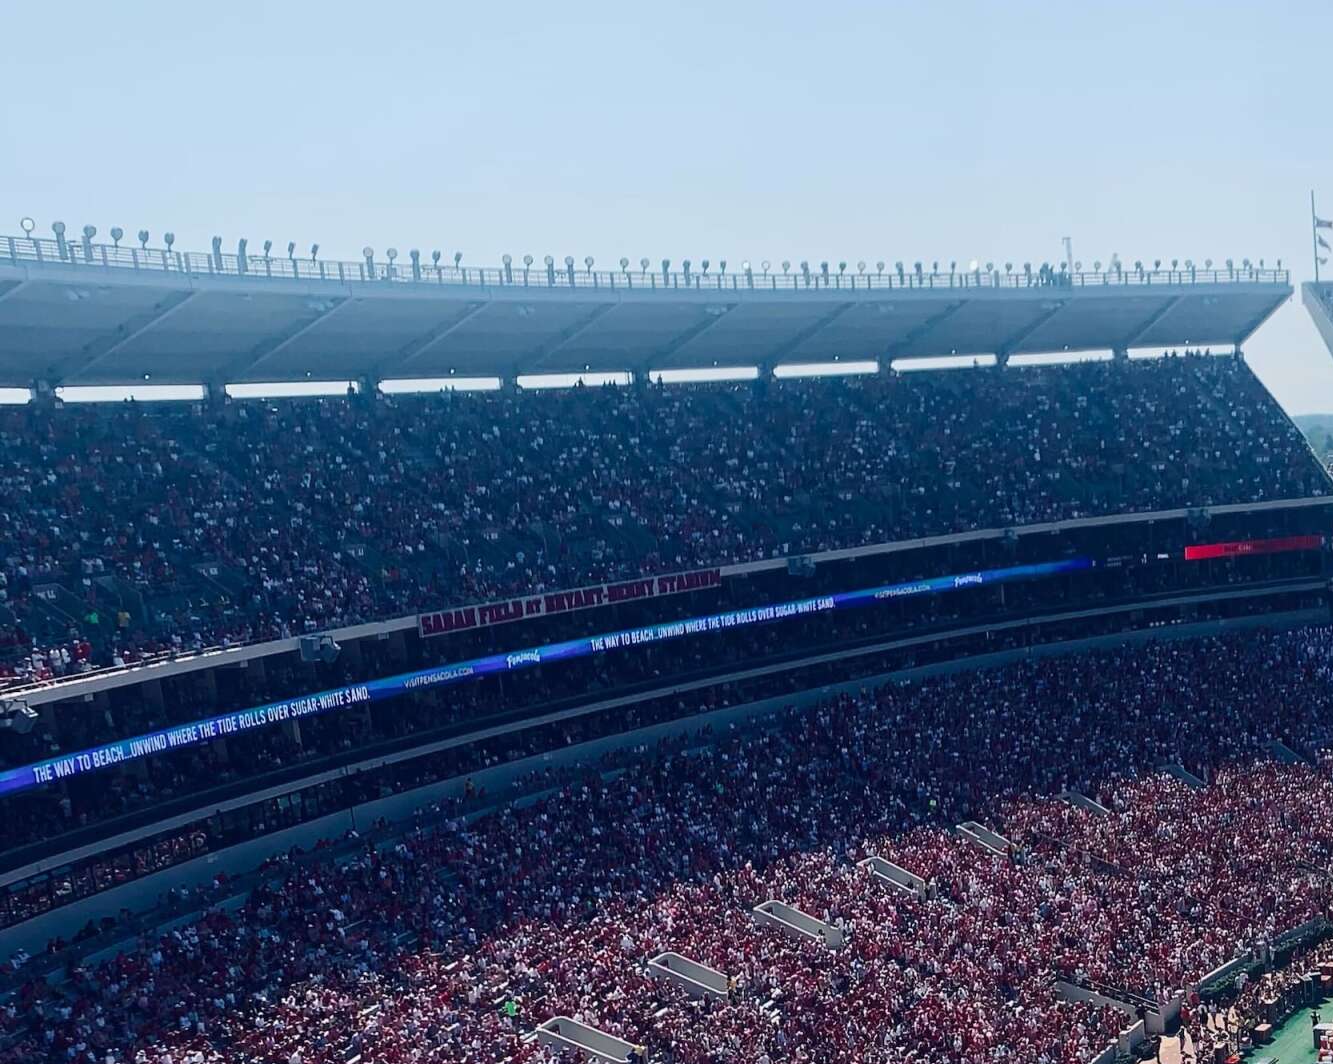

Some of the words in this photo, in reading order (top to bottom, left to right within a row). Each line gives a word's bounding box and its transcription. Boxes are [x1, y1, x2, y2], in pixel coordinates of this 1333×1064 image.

[591, 638, 603, 651] THE
[604, 636, 619, 648] WAY
[620, 633, 630, 645] TO
[685, 618, 706, 633] WHERE
[707, 615, 720, 630] THE
[720, 612, 736, 627] TIDE
[737, 610, 757, 624] ROLLS
[758, 606, 775, 620] OVER
[776, 600, 816, 618] SUGAR-WHITE
[33, 766, 53, 784] THE
[53, 762, 77, 780] WAY
[77, 757, 91, 772] TO
[167, 726, 198, 748] WHERE
[199, 721, 217, 739] THE
[217, 716, 238, 734] TIDE
[239, 711, 267, 730] ROLLS
[267, 706, 290, 723] OVER
[290, 692, 345, 717] SUGAR-WHITE
[345, 686, 371, 703] SAND.
